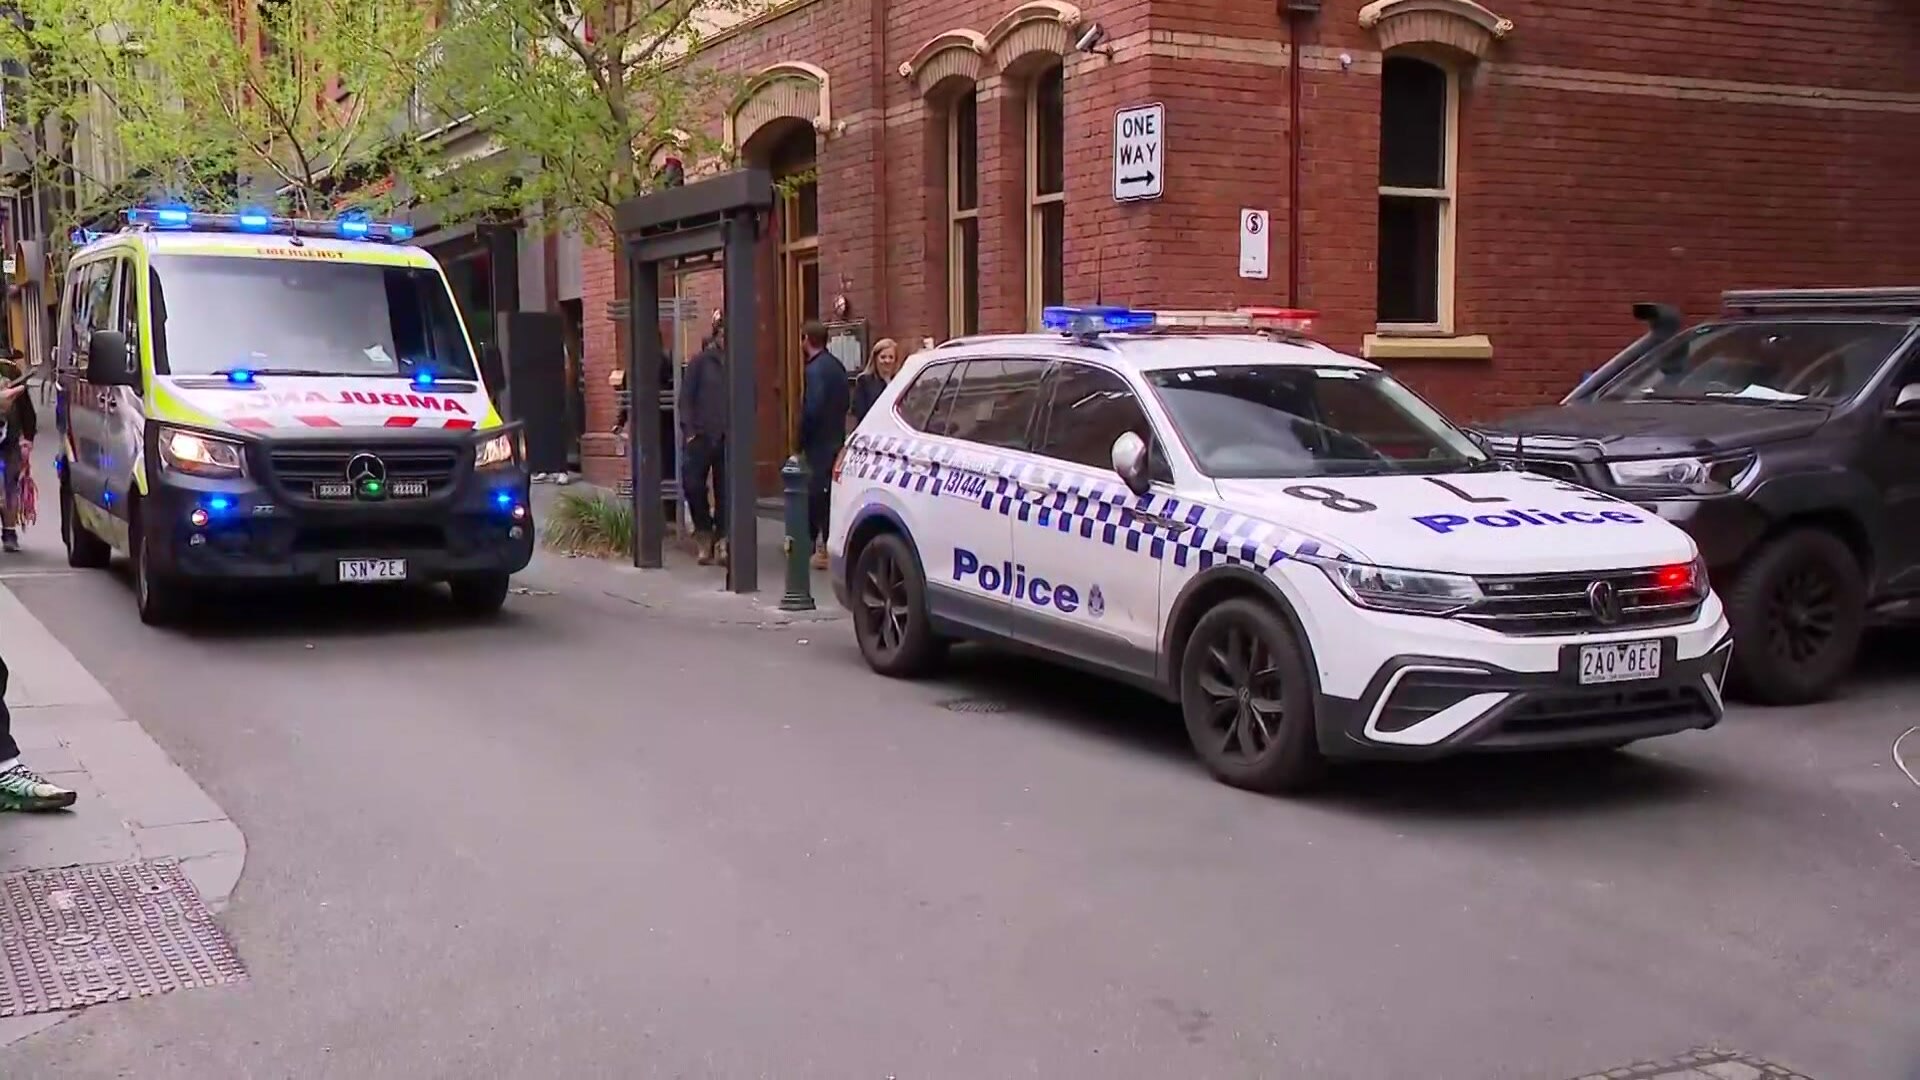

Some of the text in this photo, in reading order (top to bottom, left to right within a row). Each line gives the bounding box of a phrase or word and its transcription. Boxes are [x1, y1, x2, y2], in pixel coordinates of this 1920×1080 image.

[1122, 114, 1155, 138] ONE
[1120, 143, 1157, 165] WAY
[943, 470, 987, 499] 131444
[1282, 484, 1378, 513] 8
[1421, 476, 1512, 503] L
[1411, 508, 1644, 534] Police
[380, 561, 406, 576] 2EJ
[953, 547, 1079, 613] Police
[1628, 647, 1657, 671] 8EC
